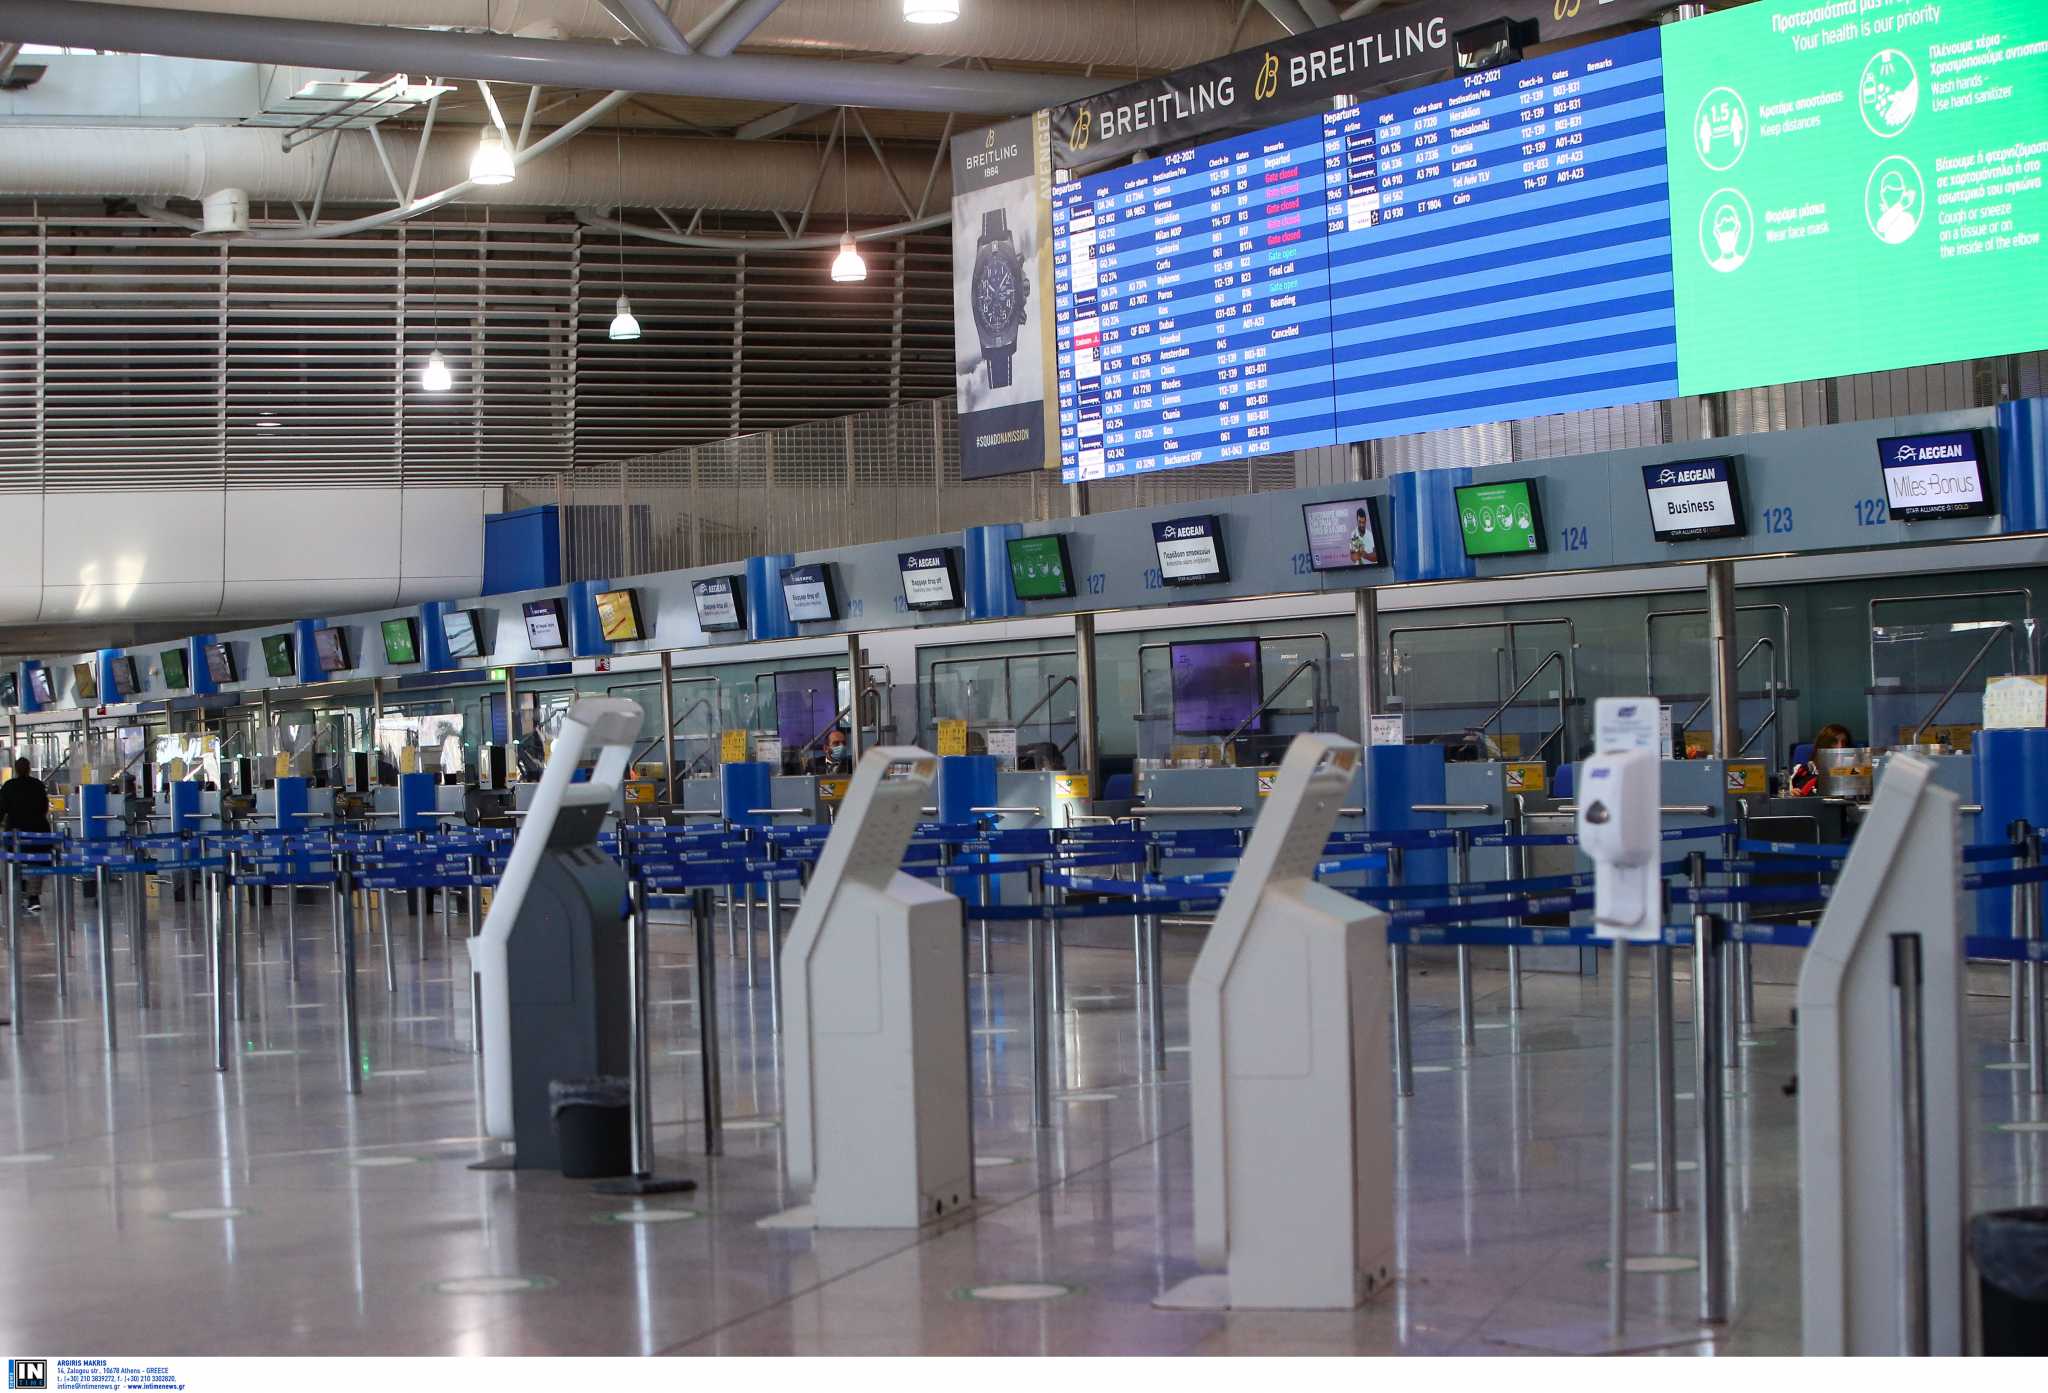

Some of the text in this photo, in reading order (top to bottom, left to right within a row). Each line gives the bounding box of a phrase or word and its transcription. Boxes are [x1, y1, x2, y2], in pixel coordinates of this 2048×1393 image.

[1792, 6, 1941, 51] Your health is our priority
[1290, 16, 1447, 88] BREITLING
[1463, 70, 1500, 88] 17-02-2021
[1932, 75, 1982, 95] Wash hands
[1324, 58, 1612, 136] Time Airline Flight Code share Destination/Via Check-in Gates Remarks
[1932, 86, 2012, 112] Use hand sanitizer
[1100, 76, 1234, 141] BREITLING
[1323, 106, 1360, 125] Departures
[1711, 102, 1729, 122] 1.5
[1390, 142, 1401, 151] 126
[1414, 136, 1423, 146] A3
[1423, 133, 1437, 143] 7126
[1449, 119, 1489, 137] Thessaloniki
[1520, 107, 1544, 120] 112-139
[1553, 98, 1580, 113] B03-B31
[1760, 115, 1820, 137] Keep distances
[966, 144, 1017, 169] BREITLING
[1208, 156, 1228, 167] Check-in
[1381, 177, 1391, 186] OA
[1391, 174, 1402, 184] 910
[1416, 169, 1424, 178] A3
[1425, 166, 1440, 176] 7910
[1451, 157, 1477, 170] Larnaca
[1522, 141, 1546, 154] 112-139
[1555, 133, 1582, 147] A01-A23
[984, 166, 999, 177] 1884
[1052, 180, 1081, 196] Departures
[1383, 210, 1391, 218] A3
[1391, 207, 1403, 217] 930
[1418, 202, 1426, 211] ET
[1452, 192, 1470, 204] Cairo
[1523, 176, 1547, 188] 114-137
[1556, 168, 1584, 181] A01-A23
[1153, 199, 1171, 210] Vienna
[1939, 203, 2012, 225] Cough or sneeze
[1939, 230, 1951, 241] on
[1961, 224, 1987, 238] tissue
[1989, 222, 1998, 233] or
[2001, 220, 2012, 231] on
[1940, 233, 2040, 258] the inside of the elbow
[1155, 259, 1170, 270] Corfu
[1157, 290, 1172, 300] Paros
[1268, 265, 1283, 276] Final
[1282, 263, 1294, 273] call
[1158, 294, 1296, 330] Dubai A12 Boarding
[1159, 325, 1298, 359] Amsterdam 045 Cancelled
[1161, 378, 1181, 389] Rhodes
[1162, 408, 1180, 419] Chania
[1163, 439, 1178, 449] Chios
[1919, 444, 1962, 460] AEGEAN
[1678, 468, 1716, 483] AEGEAN
[1668, 500, 1714, 515] Business
[1855, 499, 1886, 526] 122
[1763, 507, 1792, 533] 123
[1177, 525, 1204, 537] AEGEAN
[1561, 527, 1588, 551] 124
[918, 557, 940, 567] AEGEAN
[708, 584, 727, 592] AEGEAN
[1088, 574, 1105, 594] 127
